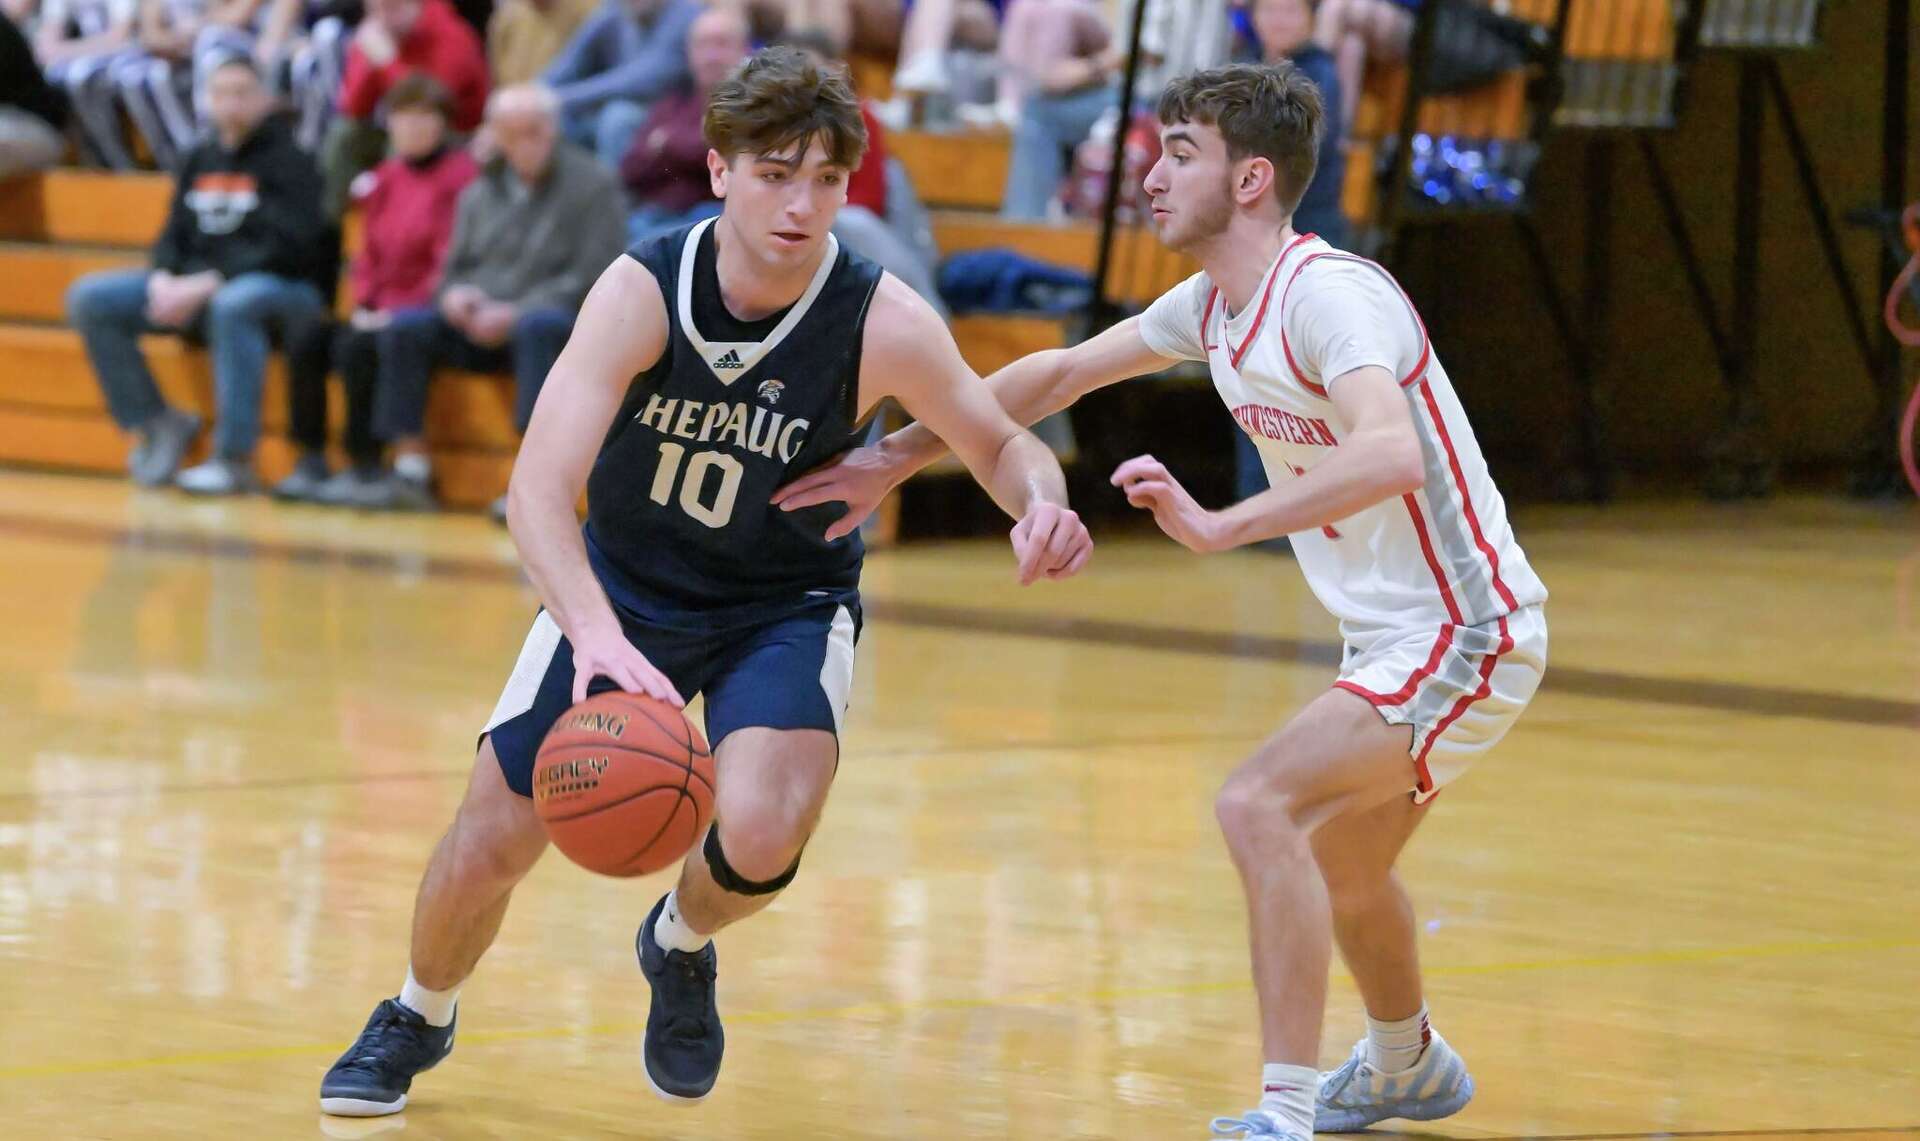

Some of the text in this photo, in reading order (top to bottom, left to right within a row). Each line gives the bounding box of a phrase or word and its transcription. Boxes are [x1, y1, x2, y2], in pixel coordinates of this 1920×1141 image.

[713, 360, 745, 369] adidas
[634, 393, 810, 464] HEPAUG
[649, 442, 744, 529] 10
